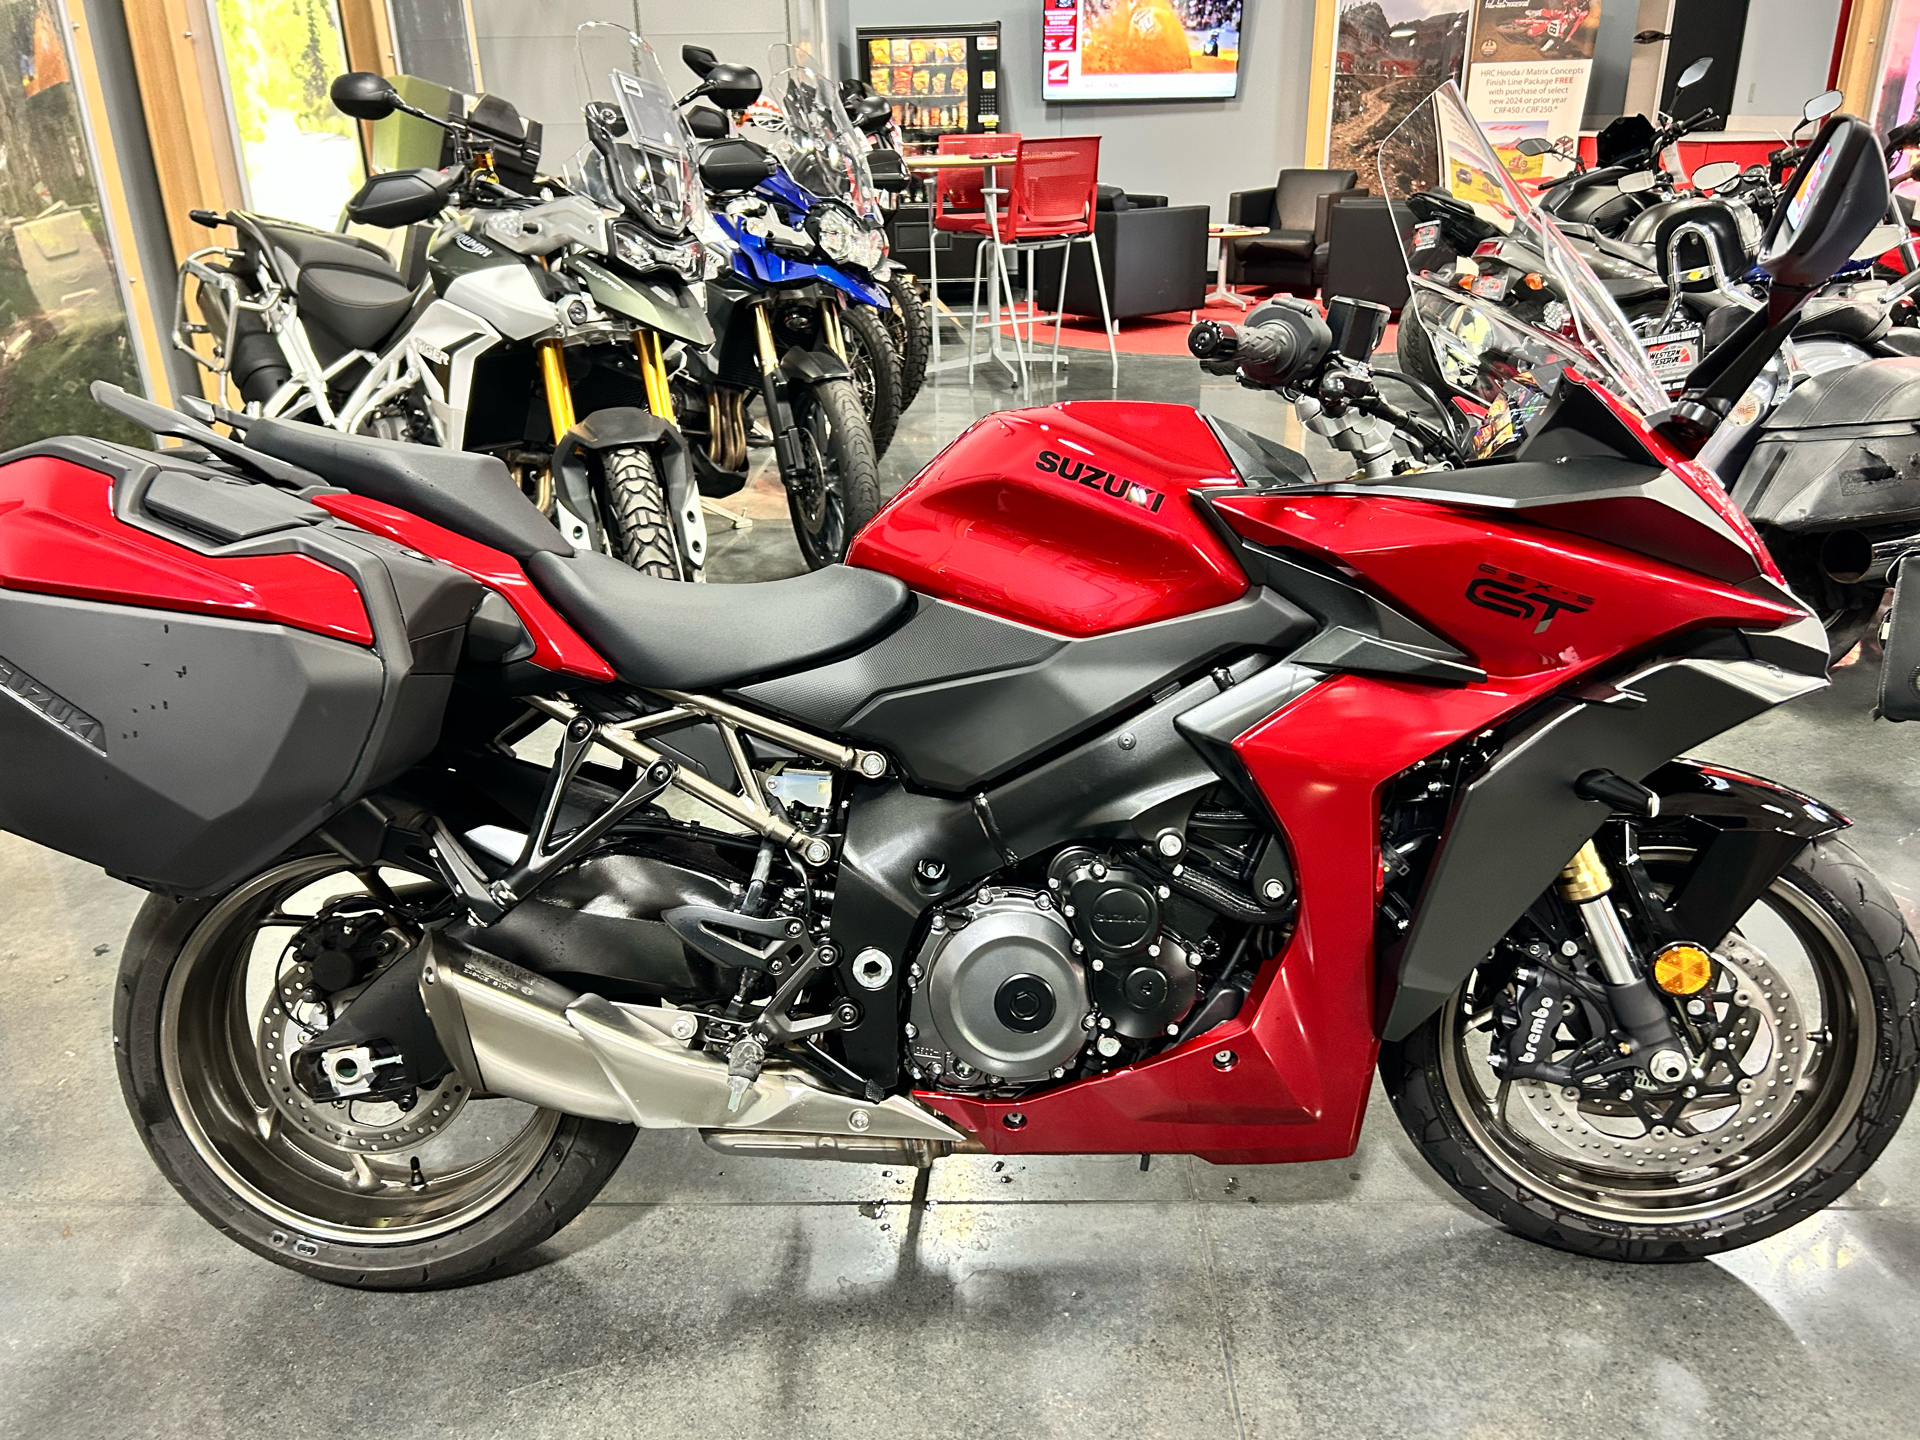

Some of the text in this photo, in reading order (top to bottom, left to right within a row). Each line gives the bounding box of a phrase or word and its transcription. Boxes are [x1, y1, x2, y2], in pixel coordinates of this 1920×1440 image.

[1480, 69, 1495, 77] HRC
[1496, 68, 1520, 76] Honda
[1526, 67, 1548, 76] Matrix
[1550, 67, 1584, 76] Concepts
[1486, 76, 1574, 87] Finish Line Package FREE
[1488, 86, 1569, 96] with purchase of select
[1493, 106, 1520, 114] CRF450
[1505, 97, 1522, 105] 2024
[1532, 97, 1550, 105] prior
[1551, 97, 1568, 105] year
[452, 232, 493, 258] TRIUMPH
[414, 336, 450, 366] TIGER
[1649, 349, 1681, 360] WESTERN
[1035, 450, 1166, 513] SUZUKI
[1477, 563, 1596, 606] GSX-S
[1465, 578, 1590, 635] GT
[1518, 996, 1554, 1063] brembo
